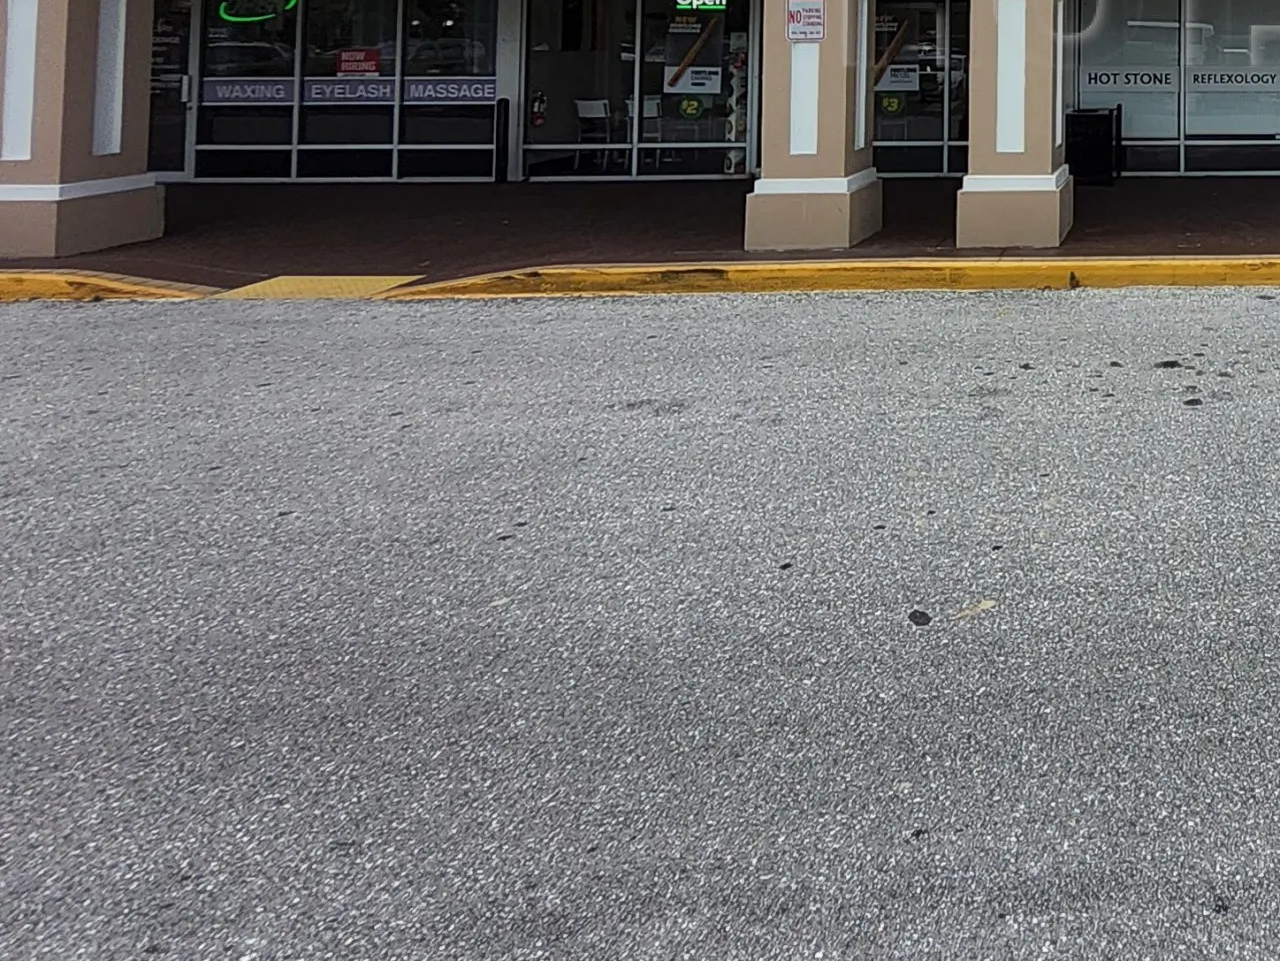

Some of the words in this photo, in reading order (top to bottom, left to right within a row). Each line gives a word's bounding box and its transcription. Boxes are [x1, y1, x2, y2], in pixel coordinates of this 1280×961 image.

[788, 9, 802, 24] NO
[1088, 72, 1121, 85] HOT
[1123, 72, 1172, 85] STONE
[1192, 73, 1277, 85] REFLEXOLOGY
[216, 85, 285, 99] WAXING
[311, 84, 391, 99] EYELASH
[409, 83, 496, 98] MASSAGE
[681, 100, 699, 115] $2
